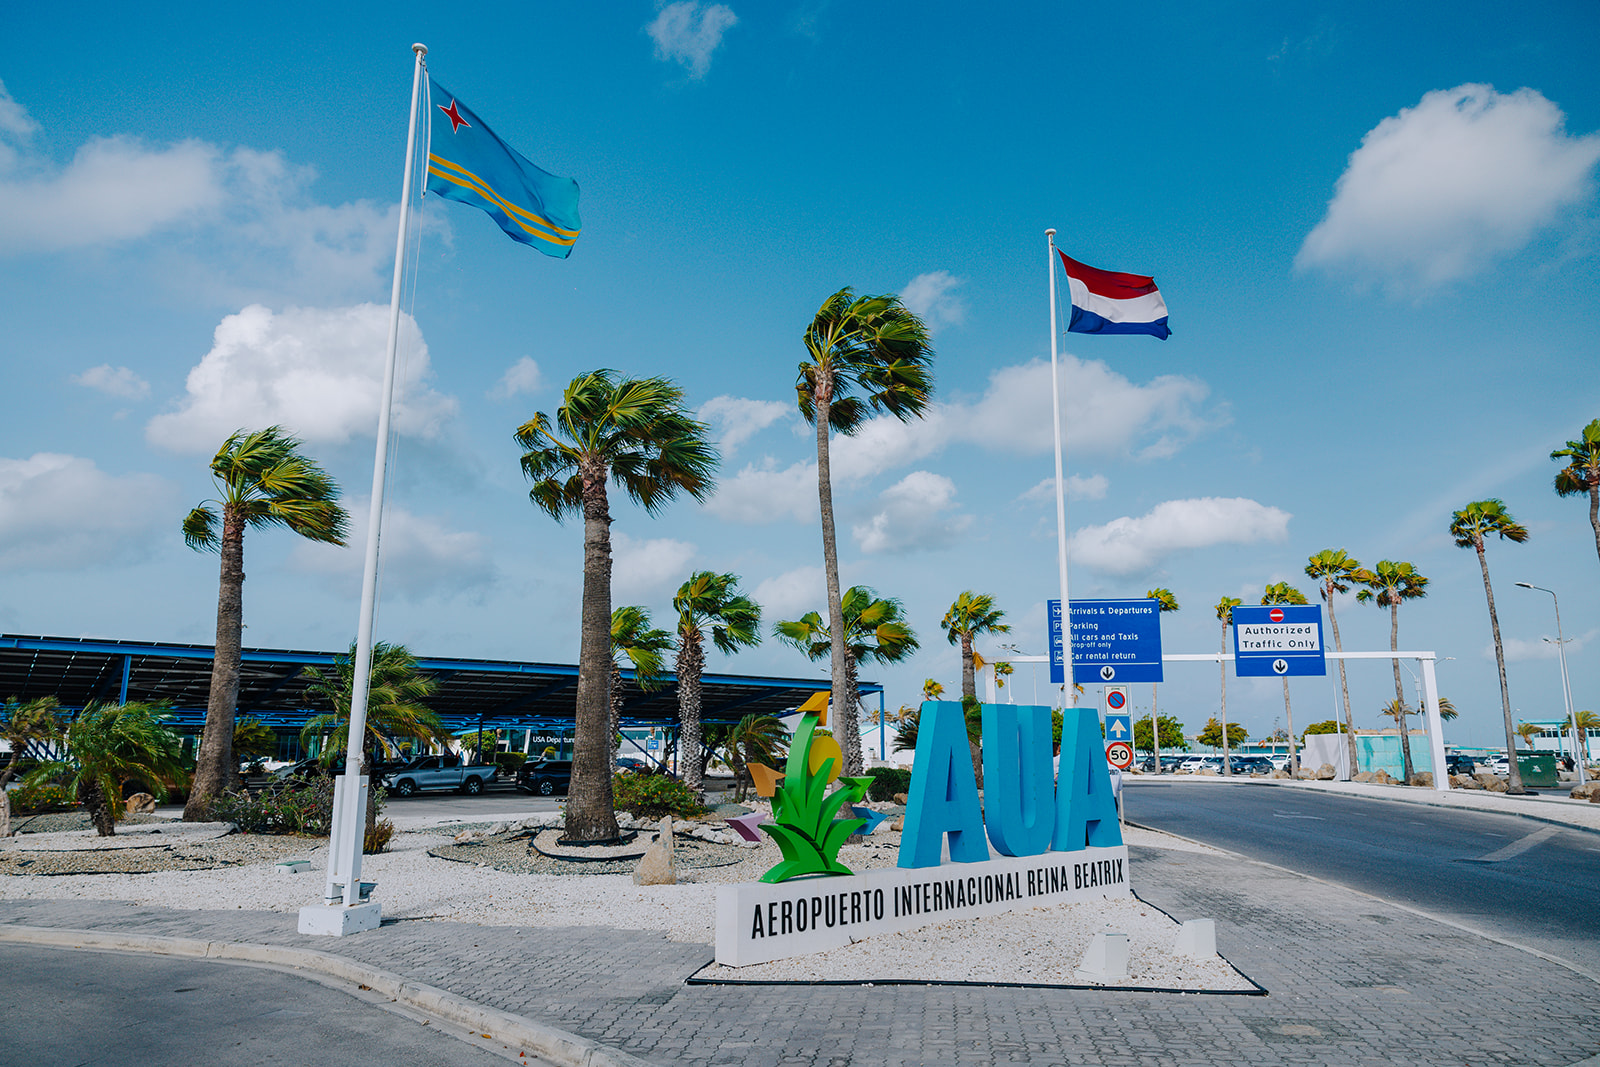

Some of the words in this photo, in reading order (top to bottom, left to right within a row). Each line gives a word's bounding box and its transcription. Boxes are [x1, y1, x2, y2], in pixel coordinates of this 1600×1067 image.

[1069, 607, 1098, 615] Arrivals
[1108, 607, 1153, 615] Departures
[1245, 626, 1311, 635] Authorized
[1243, 640, 1282, 648] Traffic
[1288, 640, 1315, 649] Only
[1086, 652, 1109, 660] rental
[1110, 750, 1128, 760] 50
[897, 700, 1124, 869] AUA
[751, 888, 884, 939] AEROPUERTO
[894, 871, 1023, 917] INTERNACIONAL
[1027, 865, 1068, 897] REINA
[1074, 858, 1124, 889] BEATRIX
